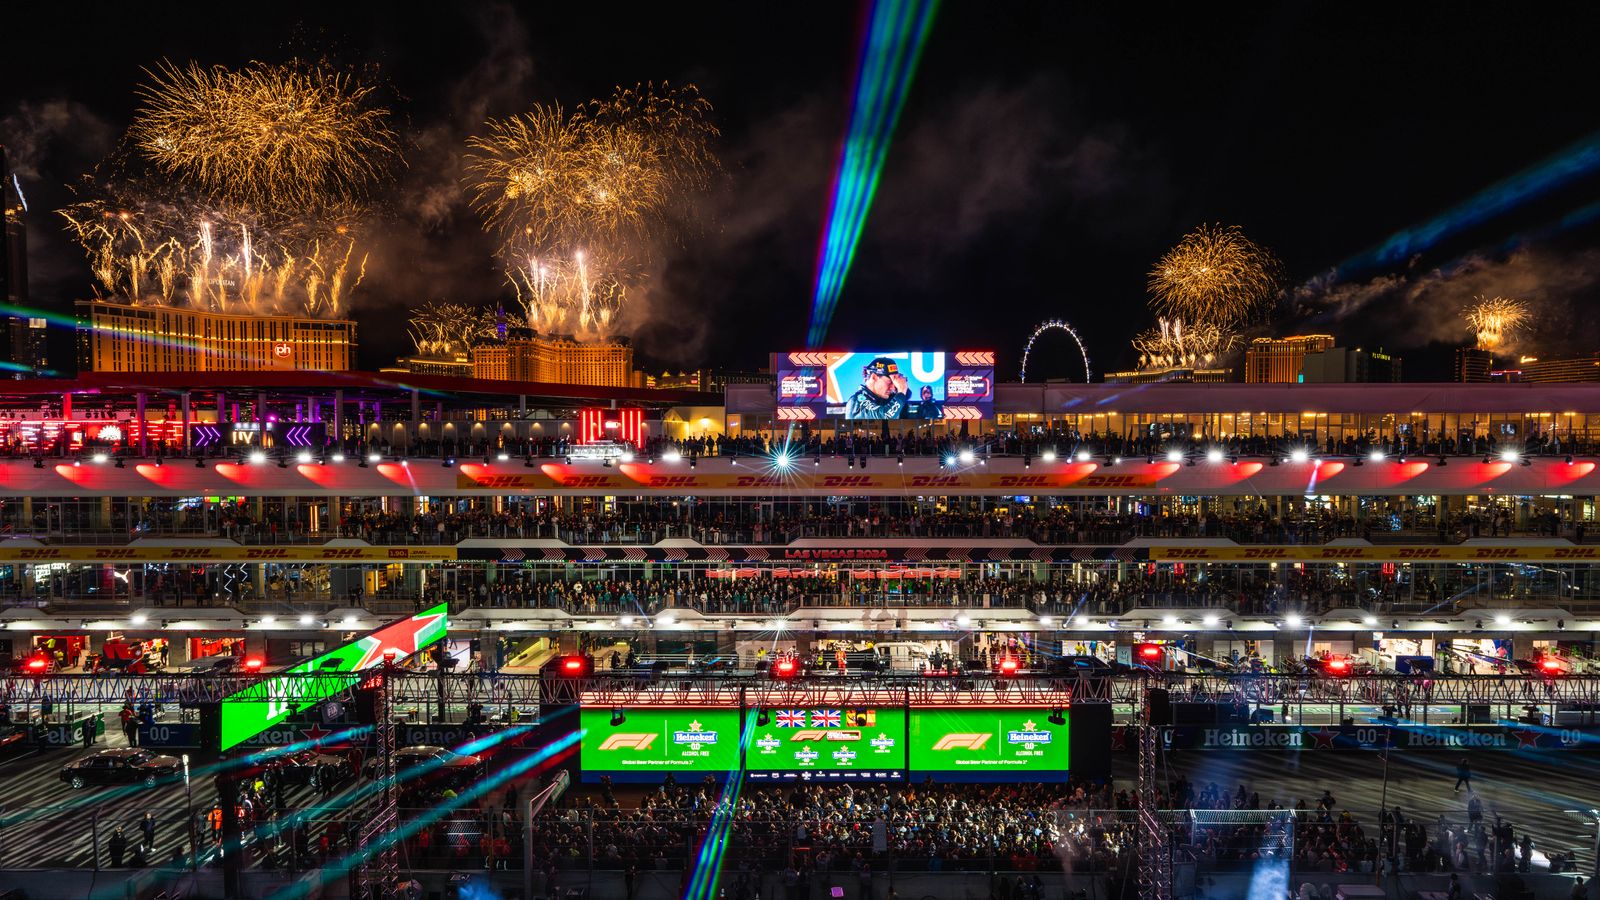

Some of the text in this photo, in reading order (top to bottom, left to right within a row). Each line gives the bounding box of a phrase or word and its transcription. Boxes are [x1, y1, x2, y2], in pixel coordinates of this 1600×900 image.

[276, 344, 291, 355] ph
[476, 476, 524, 486] DHL
[562, 476, 611, 486] DHL
[649, 476, 698, 486] DHL
[737, 476, 785, 486] DHL
[824, 476, 872, 486] DHL
[912, 476, 960, 486] DHL
[1000, 476, 1048, 486] DHL
[1088, 476, 1136, 486] DHL
[20, 549, 61, 558] DHL
[96, 549, 137, 558] DHL
[171, 549, 212, 558] DHL
[247, 549, 288, 558] DHL
[322, 549, 363, 558] DHL
[785, 549, 888, 558] LAS VEGAS 2024
[1166, 549, 1208, 558] DHL
[1244, 549, 1286, 558] DHL
[1322, 549, 1364, 558] DHL
[1399, 549, 1441, 558] DHL
[1475, 549, 1518, 558] DHL
[1553, 549, 1596, 558] DHL
[598, 733, 659, 750] F1
[676, 733, 715, 741] Heineken
[932, 733, 993, 750] F1
[1010, 733, 1049, 741] Heineken
[1203, 729, 1302, 746] Heineken
[1408, 729, 1506, 747] Heineken
